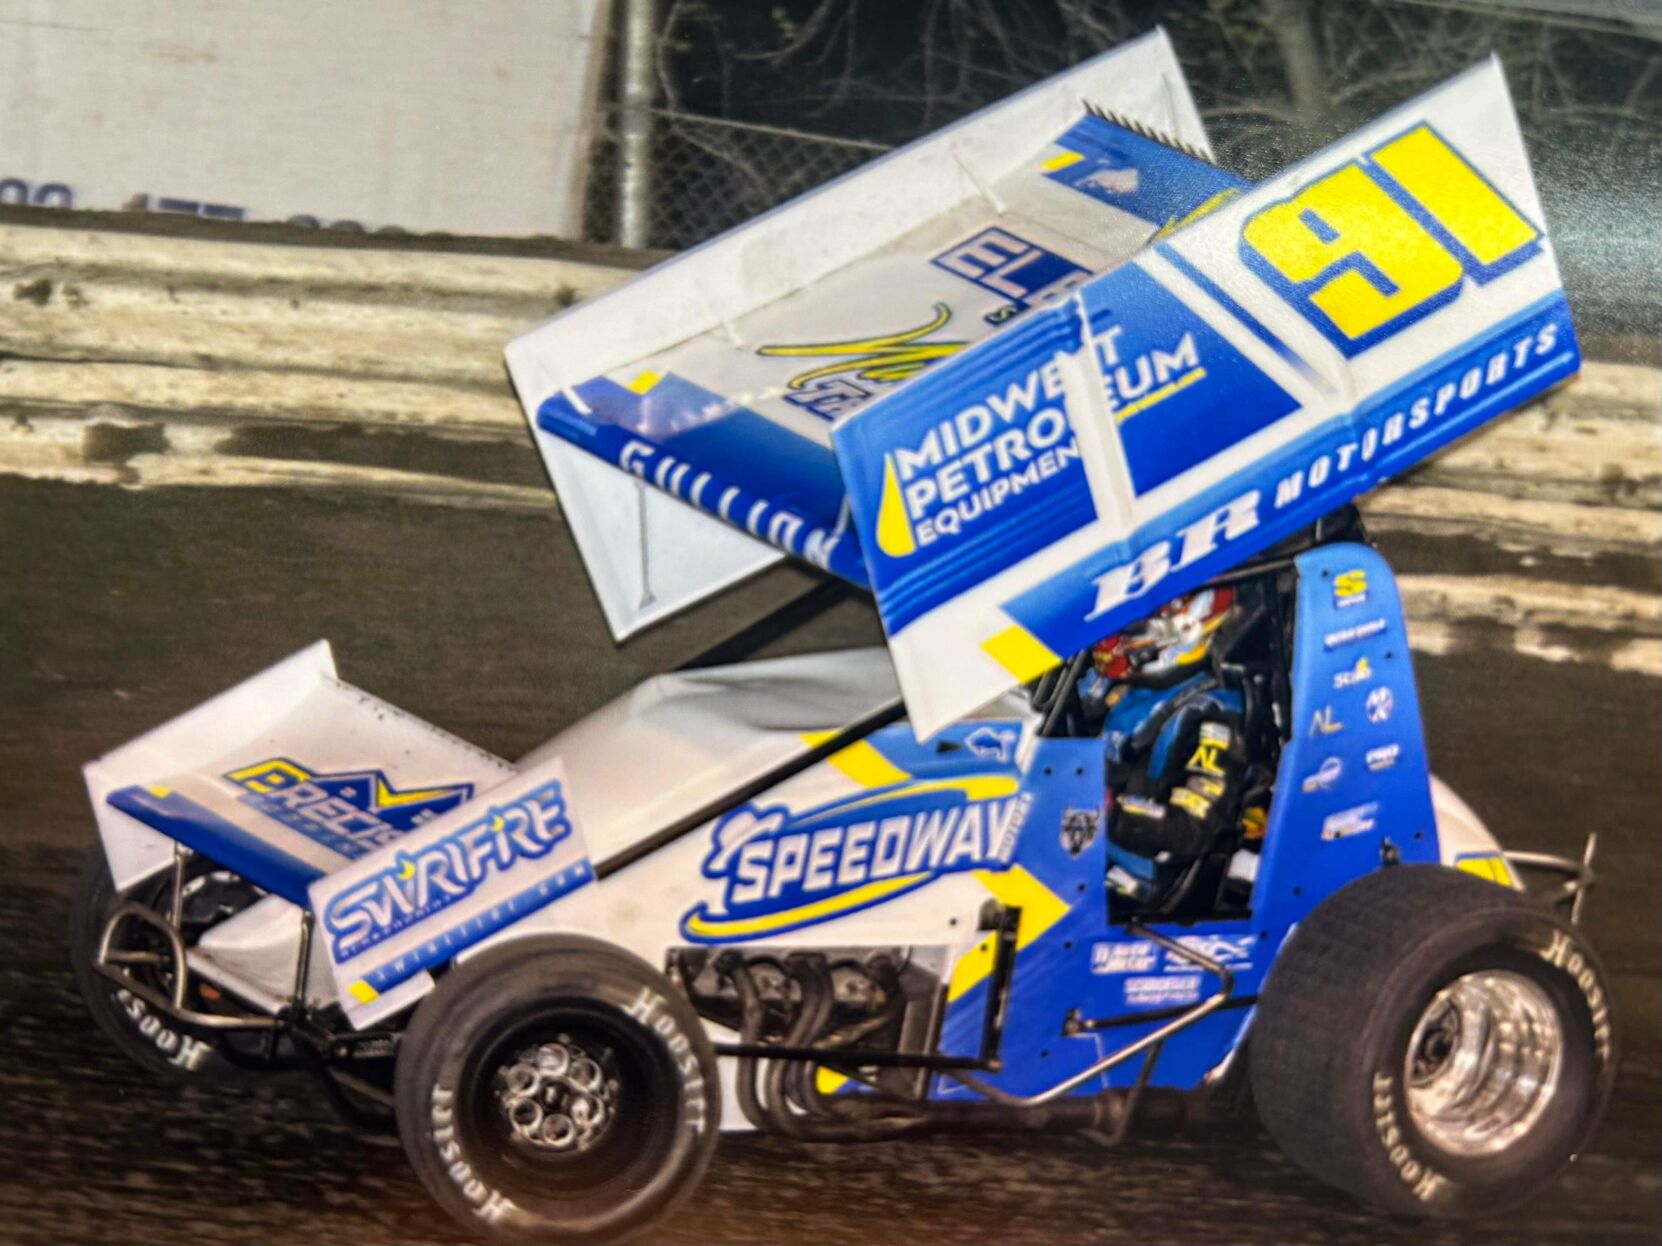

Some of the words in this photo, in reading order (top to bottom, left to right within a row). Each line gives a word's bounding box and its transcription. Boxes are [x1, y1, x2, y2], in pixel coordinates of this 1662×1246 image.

[1238, 120, 1545, 360] 91
[894, 325, 1123, 480] MIDWET
[904, 333, 1199, 519] PETROUM
[1274, 323, 1559, 508] MOTORSPORTS
[915, 437, 1081, 548] EQUIPMEN
[730, 798, 1019, 903] SPEEDWAY
